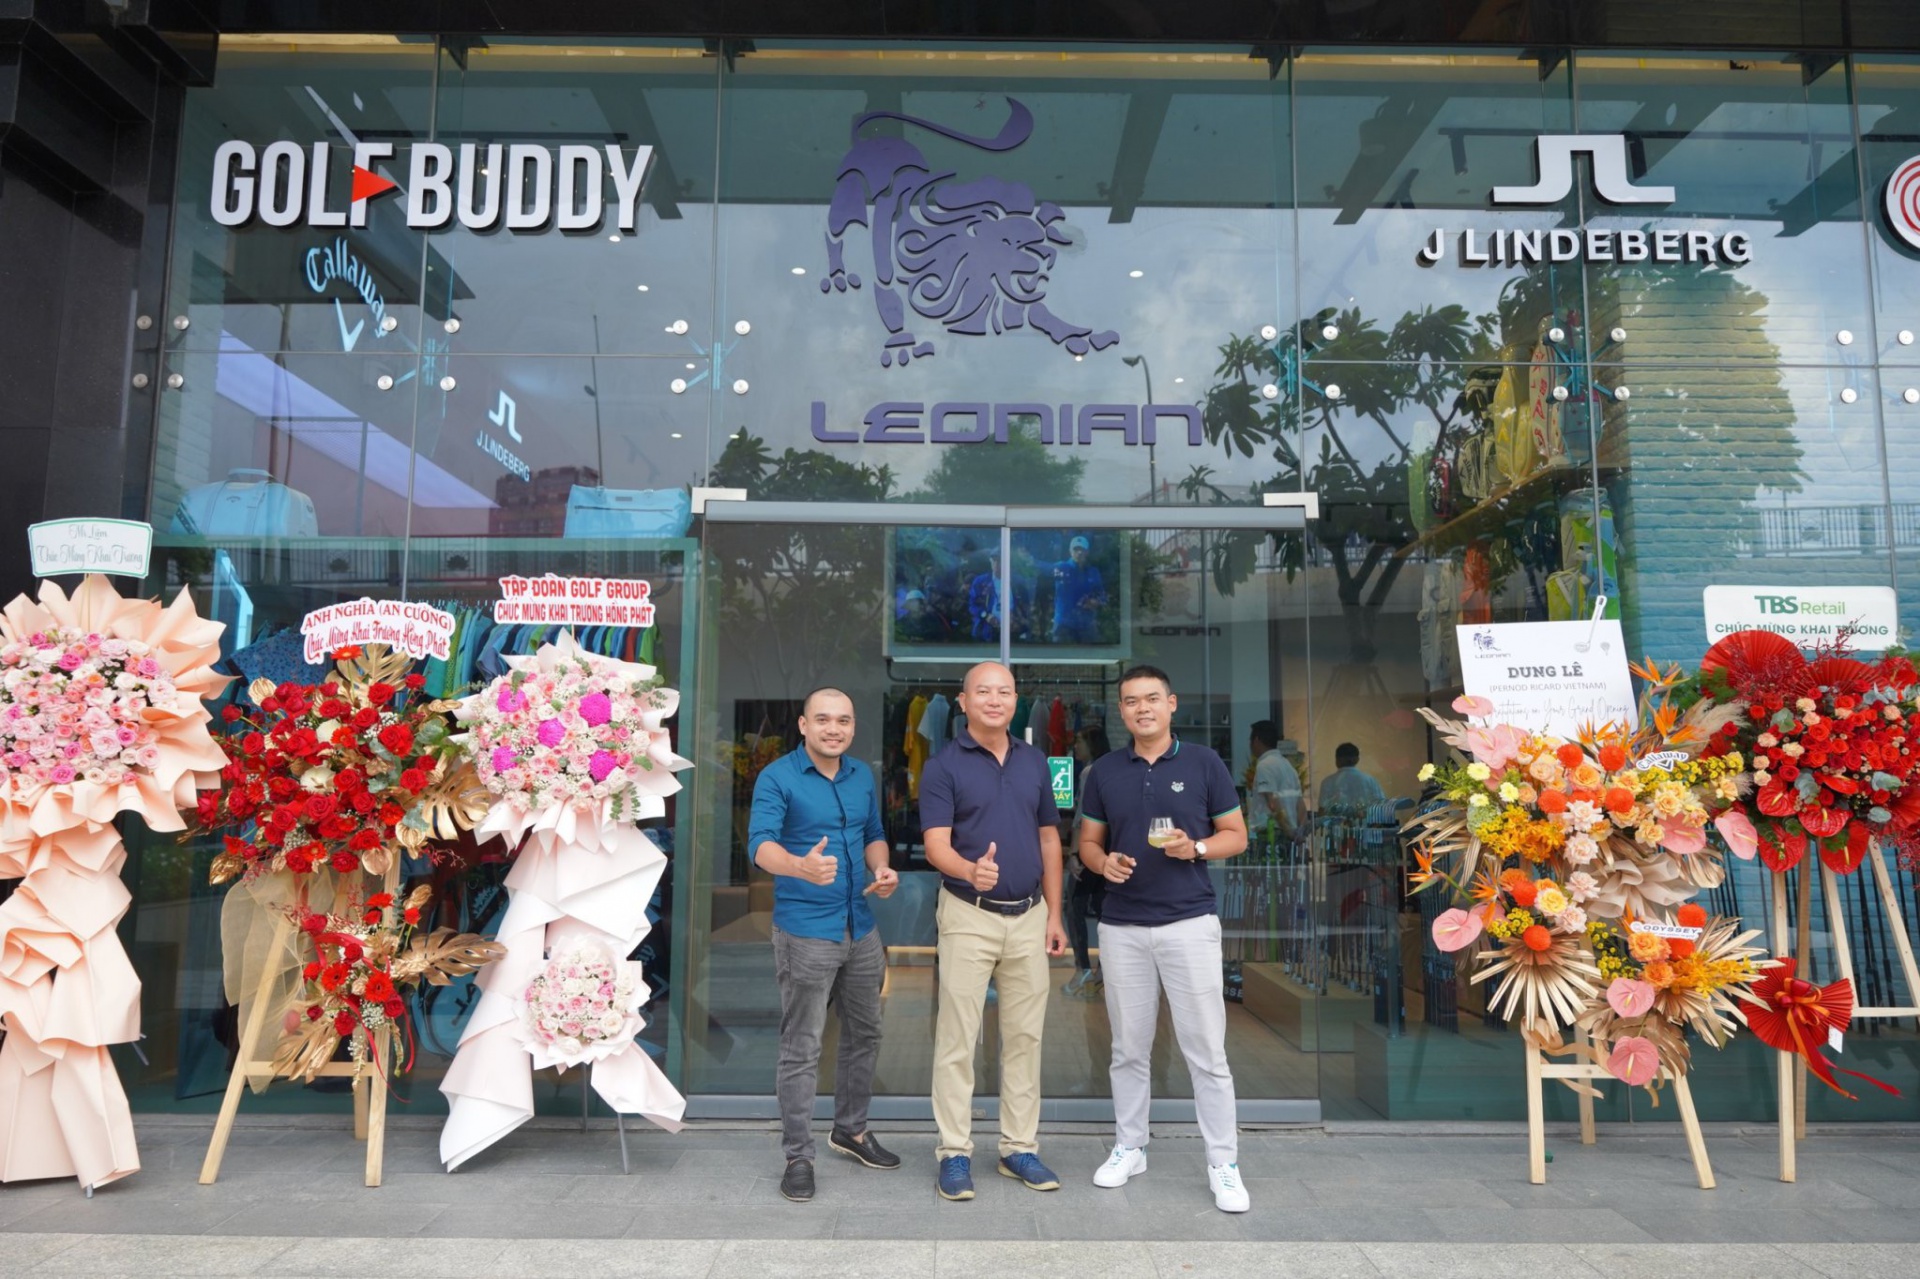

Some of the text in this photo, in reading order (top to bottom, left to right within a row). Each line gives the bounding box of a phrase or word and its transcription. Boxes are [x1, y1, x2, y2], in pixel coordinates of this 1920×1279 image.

[210, 140, 654, 229] GOLF BUDDY
[1423, 228, 1754, 262] J LINDEBERG
[810, 401, 1203, 446] LEONIAN
[532, 574, 566, 597] ĐOÀN
[571, 580, 602, 598] GOLF
[606, 581, 648, 600] GROUP
[549, 603, 568, 621] KHAI
[1754, 595, 1846, 615] TBS Retail
[304, 609, 331, 631] ANH
[379, 604, 400, 616] (AN
[351, 621, 370, 642] Khai
[1801, 624, 1831, 634] KHAI
[1507, 661, 1583, 678] DUNG LÊ
[1489, 682, 1607, 692] (PERNOD RICARD VIETNAM)
[1638, 752, 1688, 769] Callaway
[1643, 925, 1698, 934] ODYSSEY
